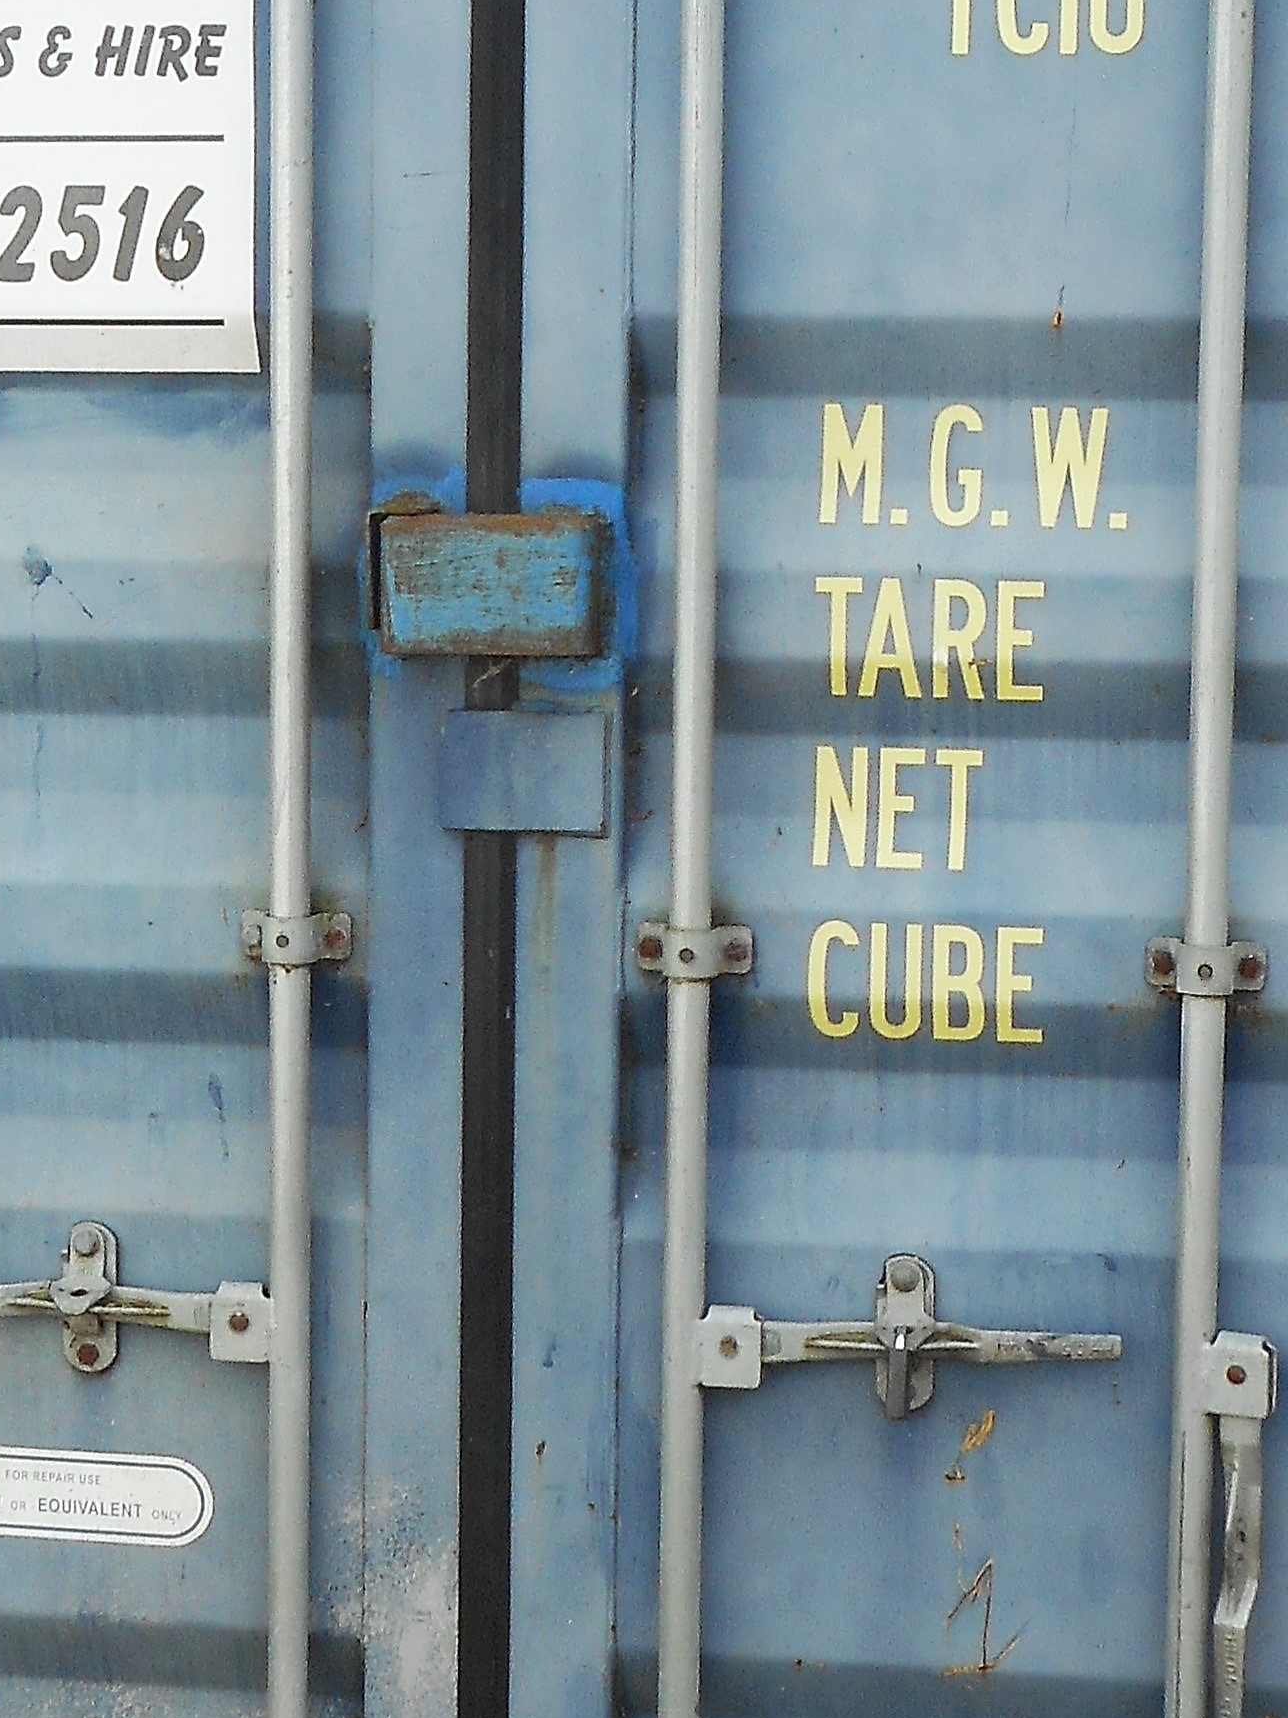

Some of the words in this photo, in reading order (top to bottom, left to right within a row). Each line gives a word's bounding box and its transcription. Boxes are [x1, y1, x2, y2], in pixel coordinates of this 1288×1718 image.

[38, 25, 74, 79] &
[94, 23, 228, 82] HIRE
[813, 575, 1047, 703] TARE
[809, 743, 987, 873] NET
[804, 918, 1046, 1046] CUBE
[4, 1468, 30, 1482] FOR
[33, 1470, 76, 1485] REPAIR
[79, 1474, 102, 1486] USE
[10, 1499, 27, 1512] OR
[37, 1496, 144, 1520] EQUIVALENT
[150, 1507, 184, 1523] ONLY
